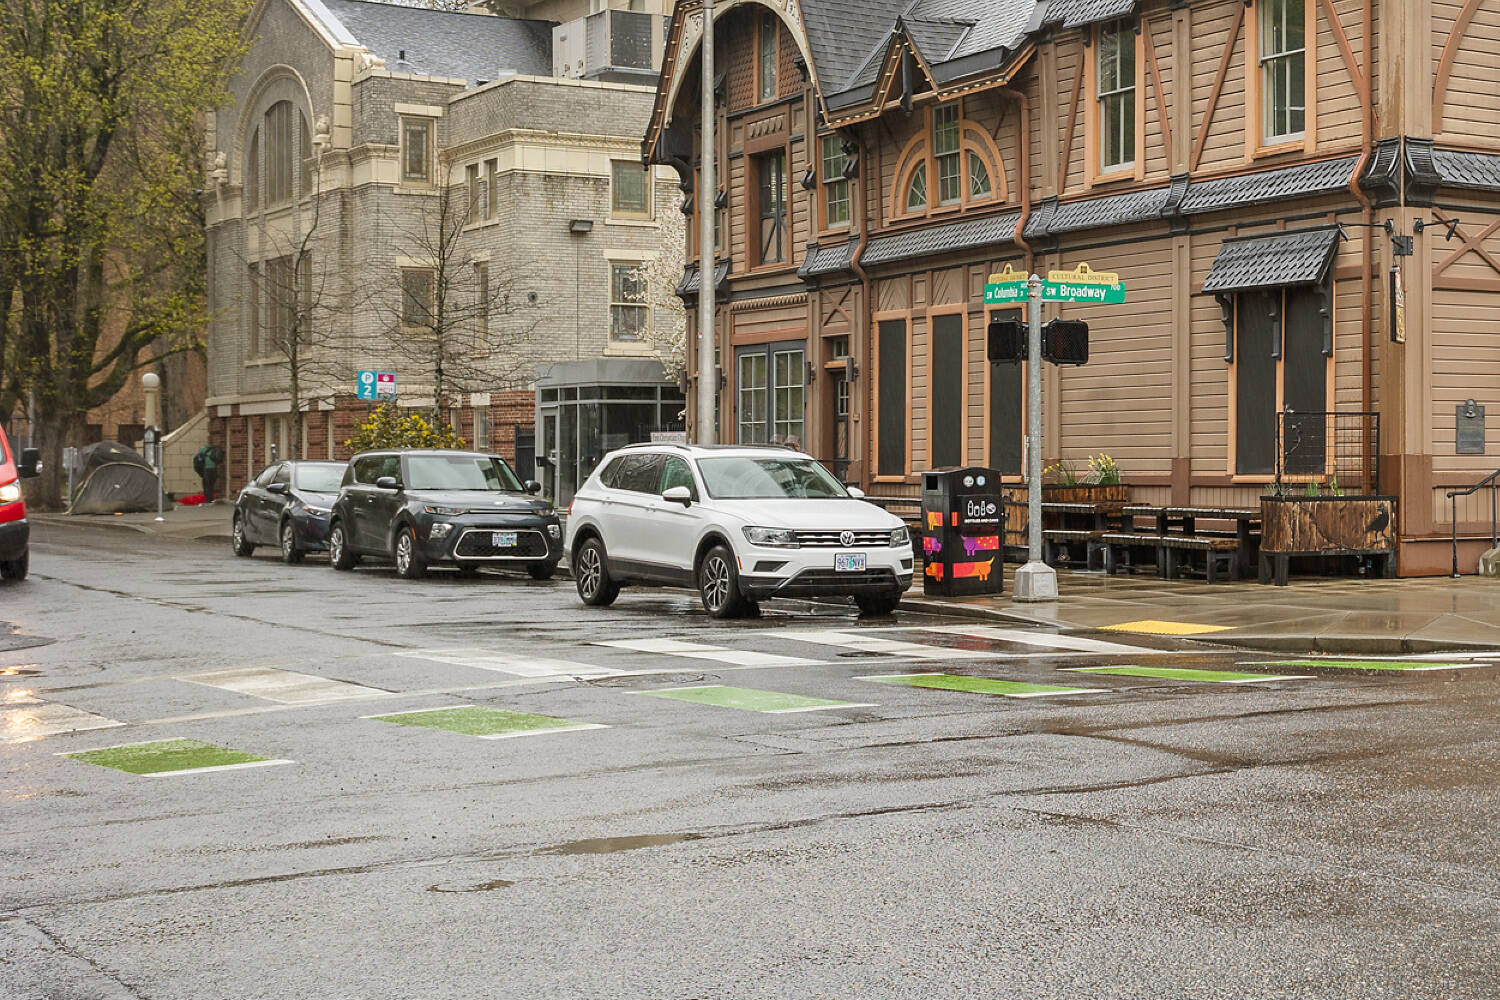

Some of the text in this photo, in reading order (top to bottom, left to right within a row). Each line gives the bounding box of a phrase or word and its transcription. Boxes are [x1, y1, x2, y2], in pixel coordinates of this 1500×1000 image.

[994, 287, 1018, 298] Columbia
[1060, 285, 1107, 301] Broadway
[363, 385, 372, 396] 2
